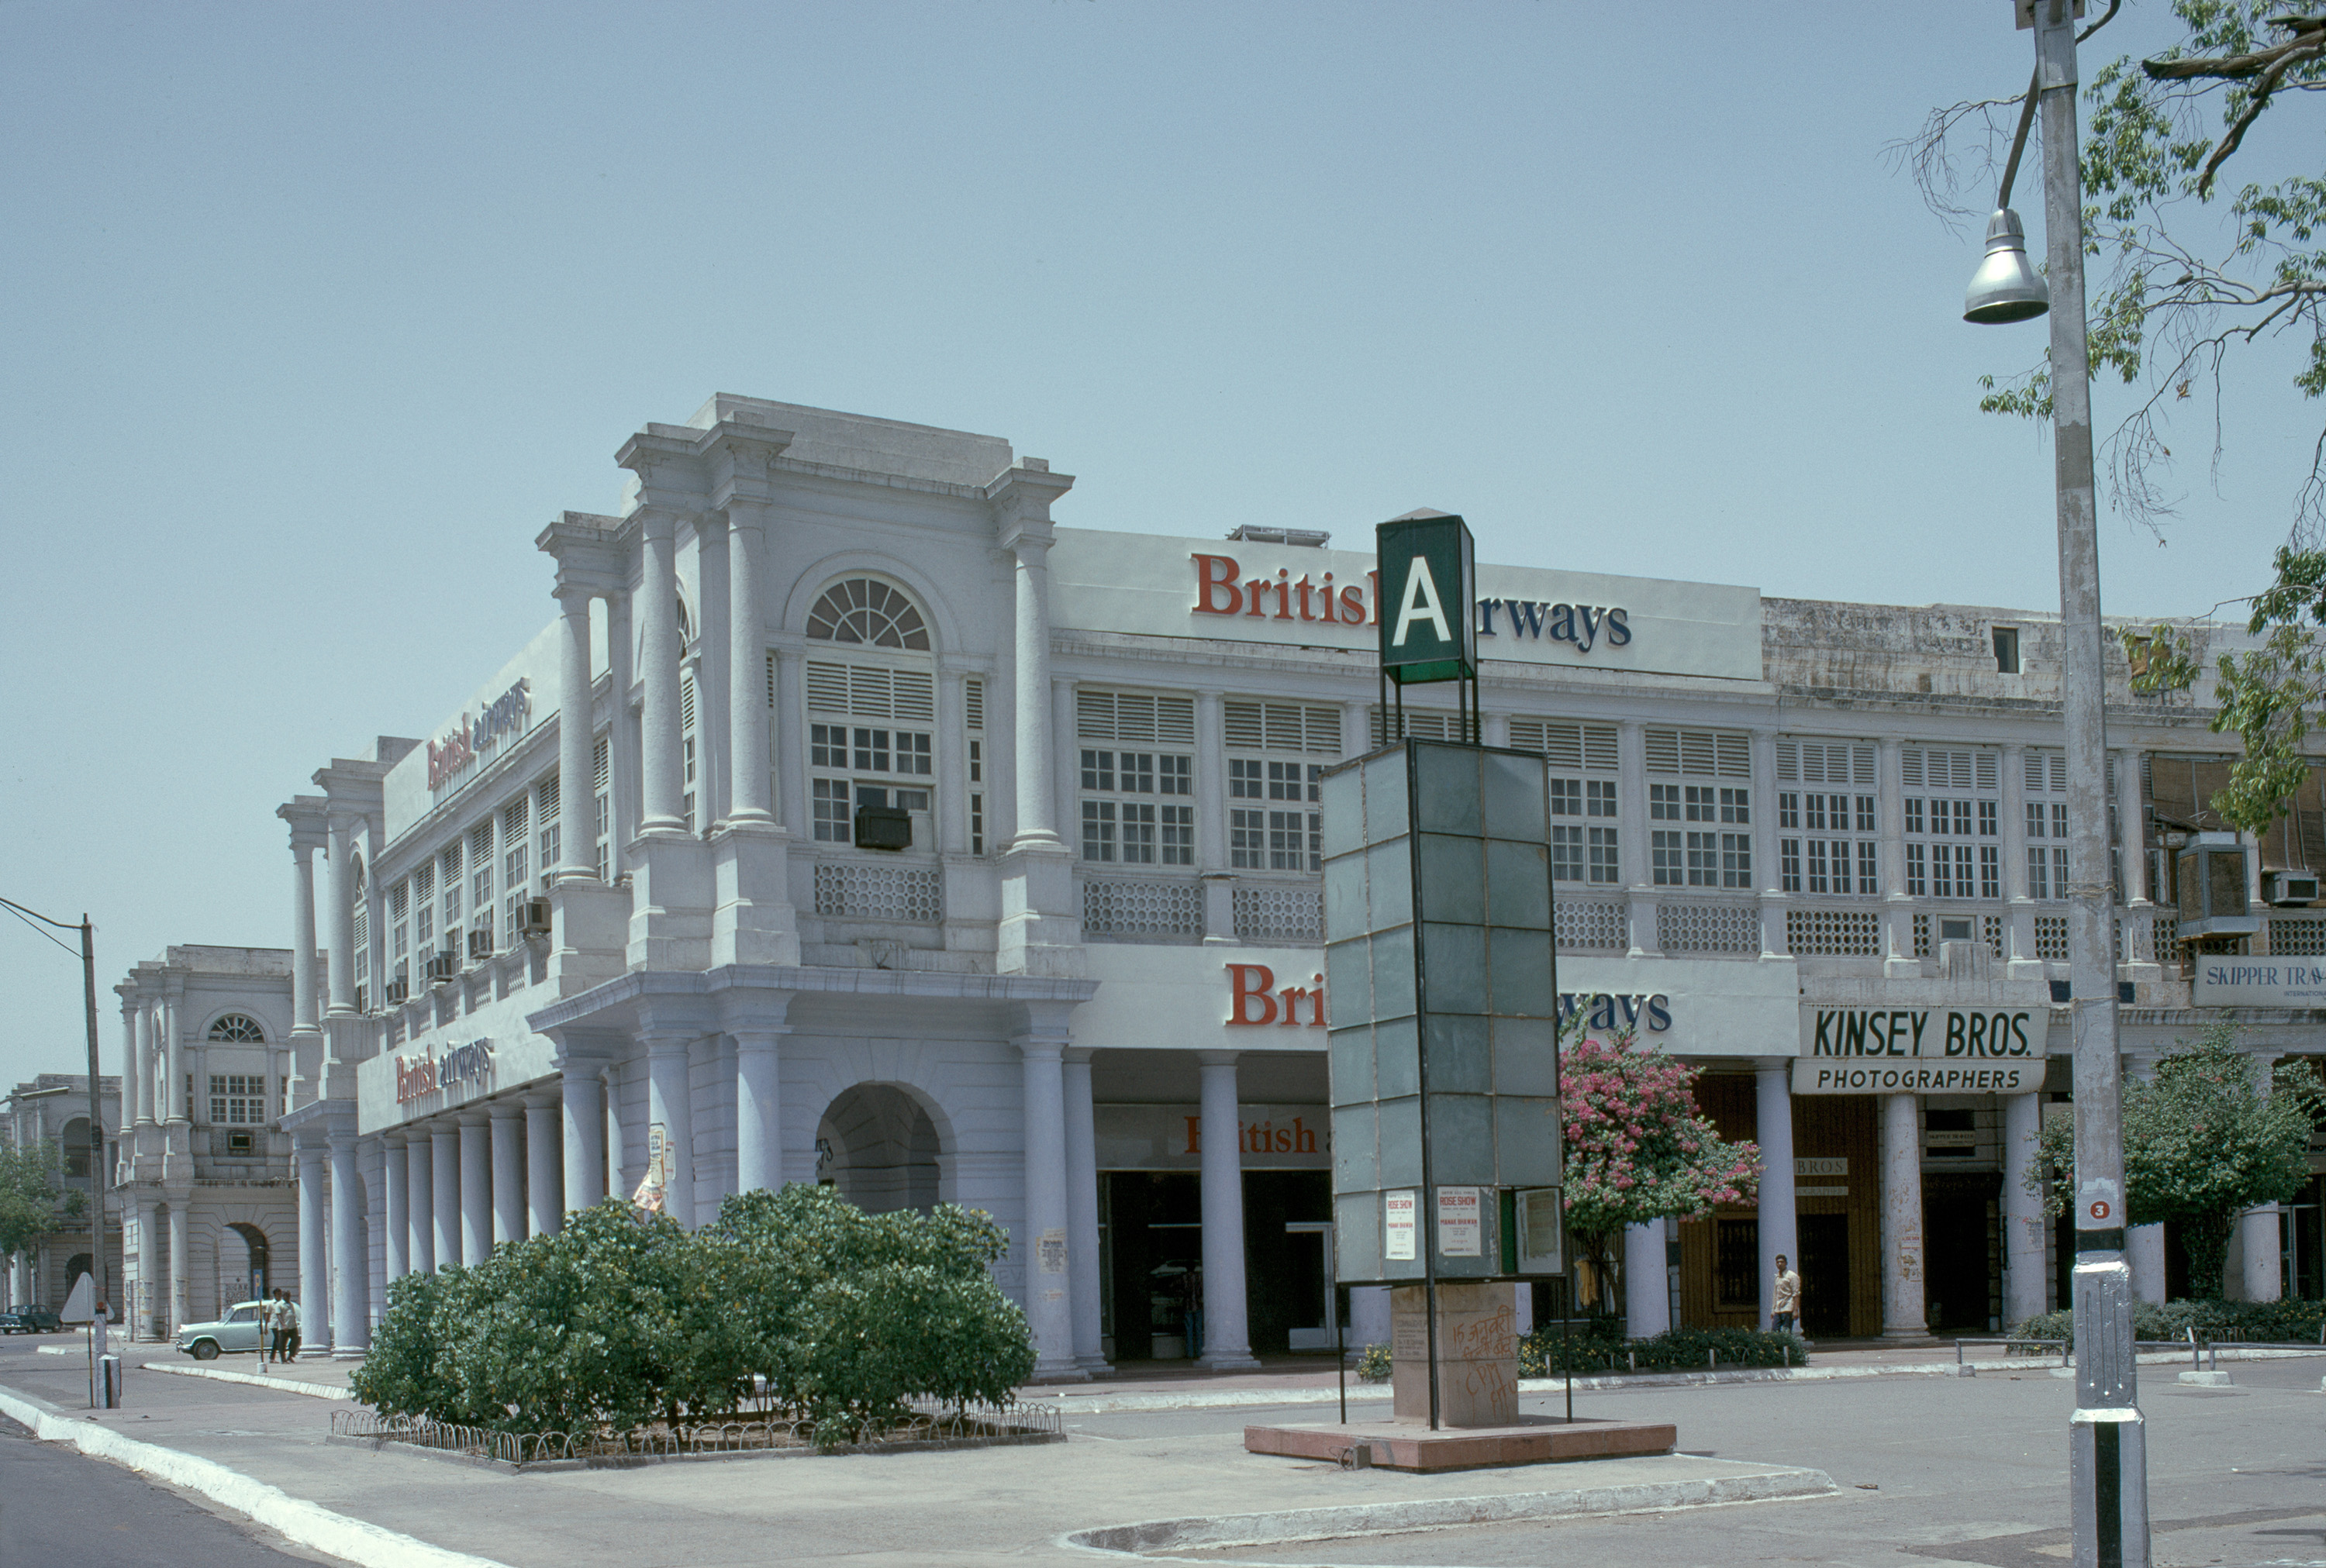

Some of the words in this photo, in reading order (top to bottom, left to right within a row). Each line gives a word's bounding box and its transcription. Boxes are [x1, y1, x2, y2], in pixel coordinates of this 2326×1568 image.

[1392, 556, 1451, 646] A
[1477, 598, 1632, 653] rways
[426, 712, 472, 791] British
[473, 677, 531, 751] airways
[2206, 967, 2279, 985] SKIPPER
[1557, 992, 1672, 1036] ways
[1814, 1010, 1929, 1056] KINSEY
[1945, 1011, 2031, 1057] BROS.
[395, 1044, 437, 1104] British
[440, 1036, 493, 1088] airways
[1817, 1070, 2020, 1088] PHOTOGRAPHERS
[1184, 1116, 1318, 1153] itish
[1797, 1159, 1844, 1174] BROS
[1387, 1200, 1399, 1210] ROSE
[1399, 1200, 1413, 1209] SHOW
[1439, 1196, 1457, 1206] ROSE
[1457, 1196, 1477, 1206] SHOW
[2095, 1204, 2104, 1216] 3
[1465, 1362, 1502, 1395] CPM
